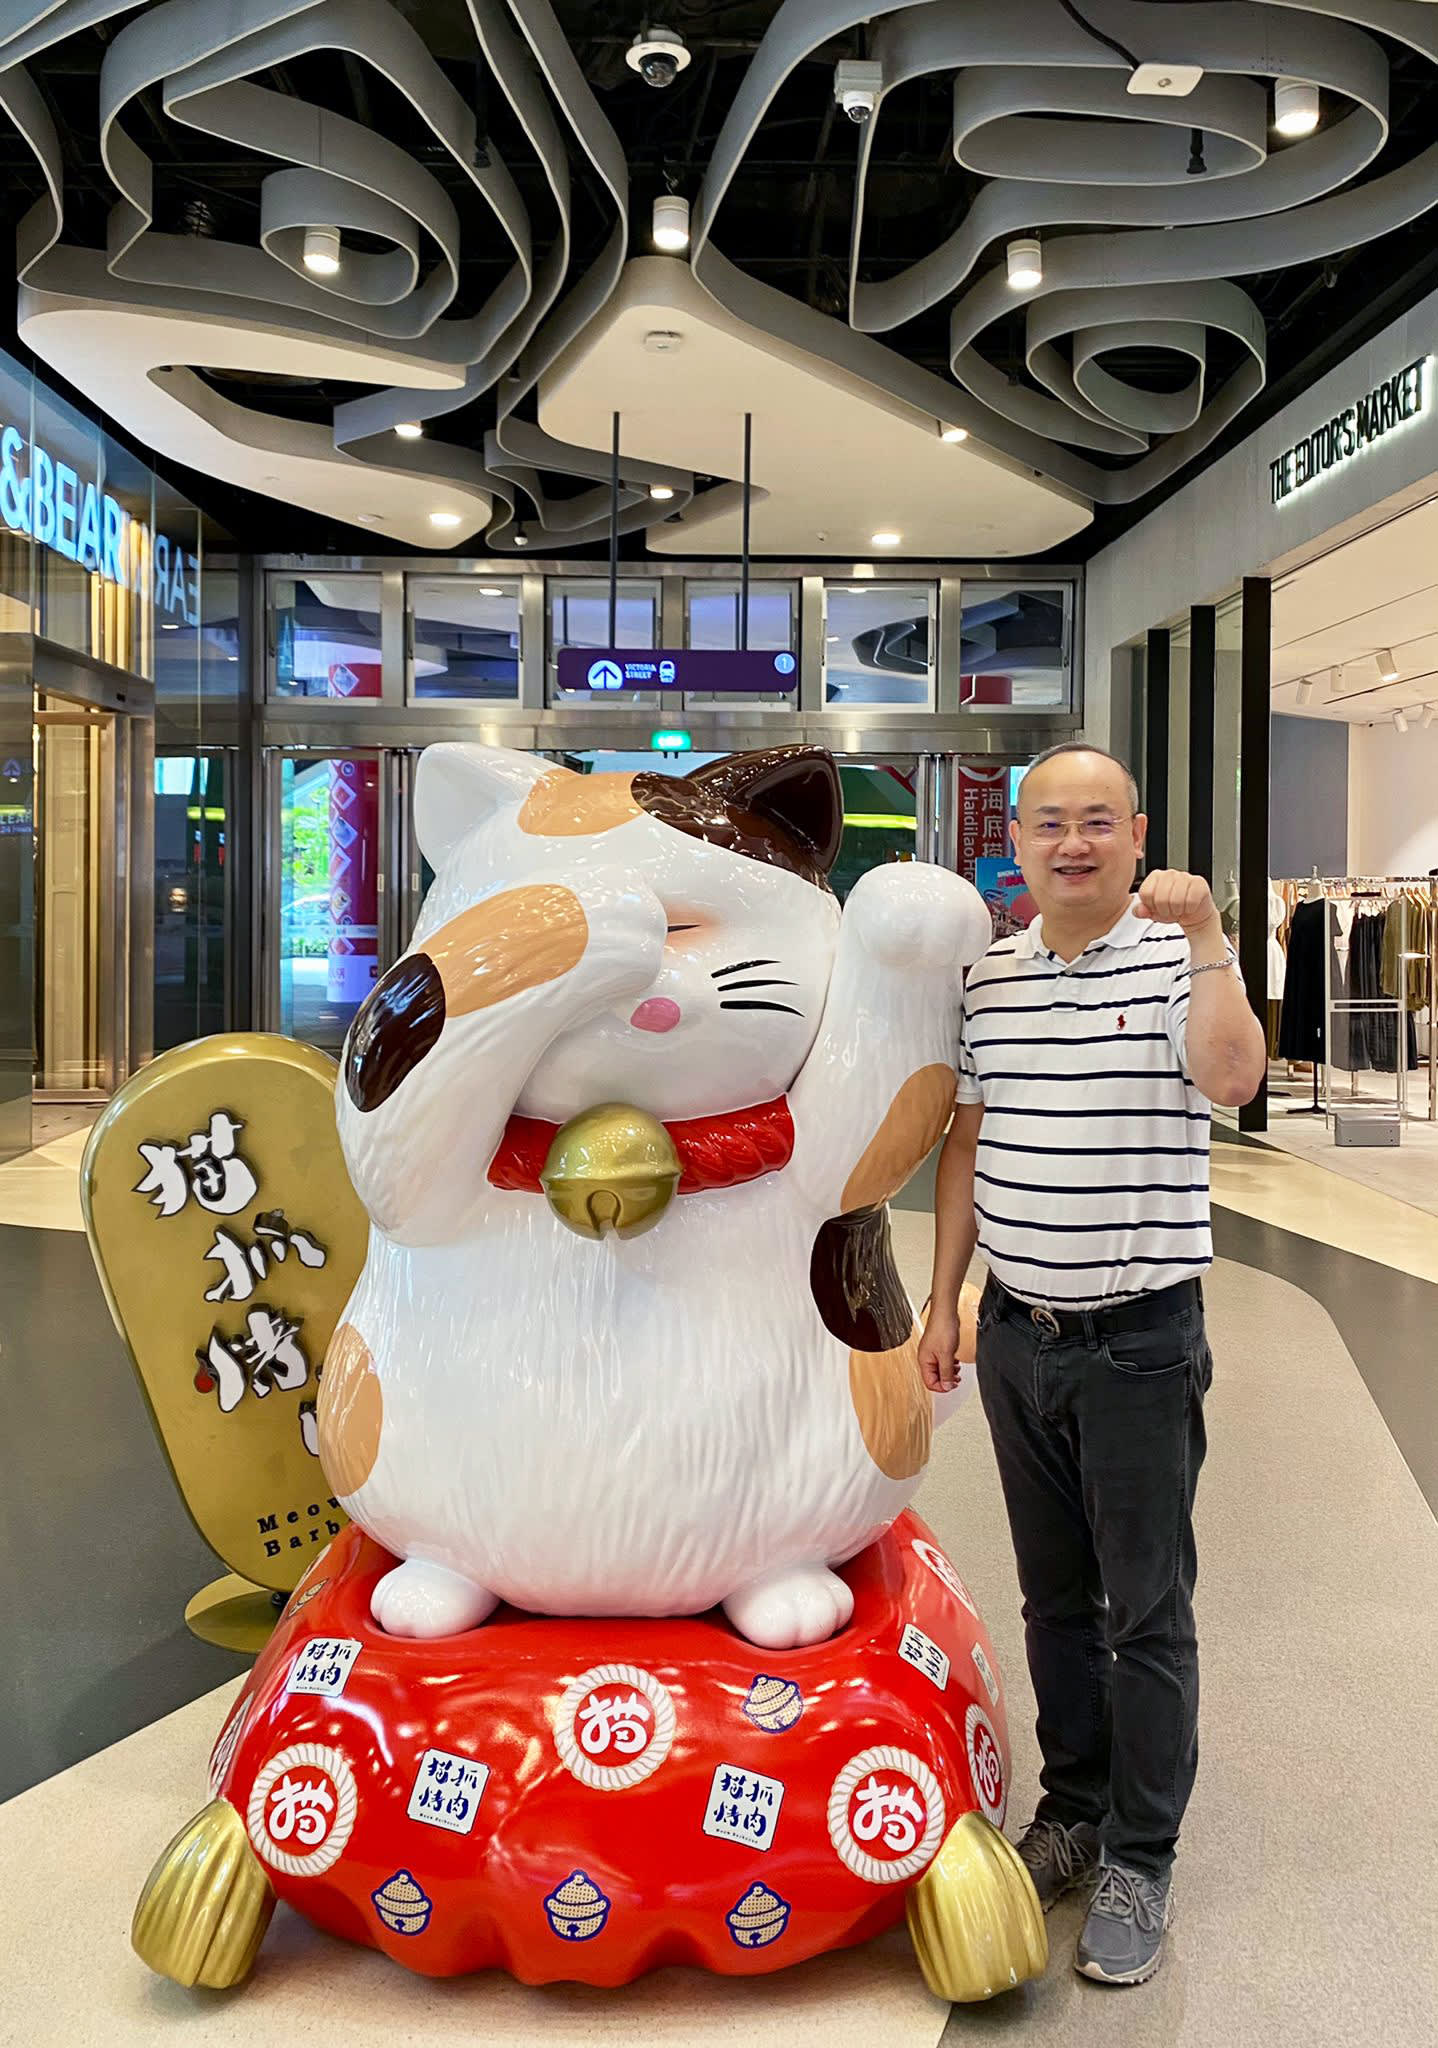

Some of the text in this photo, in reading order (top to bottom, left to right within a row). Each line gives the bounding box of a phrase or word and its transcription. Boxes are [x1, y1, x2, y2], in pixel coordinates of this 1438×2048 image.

[1270, 449, 1296, 504] THE
[1356, 354, 1430, 449] MARKET
[624, 671, 653, 679] STREET
[963, 788, 978, 855] Haidilao
[264, 1520, 341, 1557] Barb
